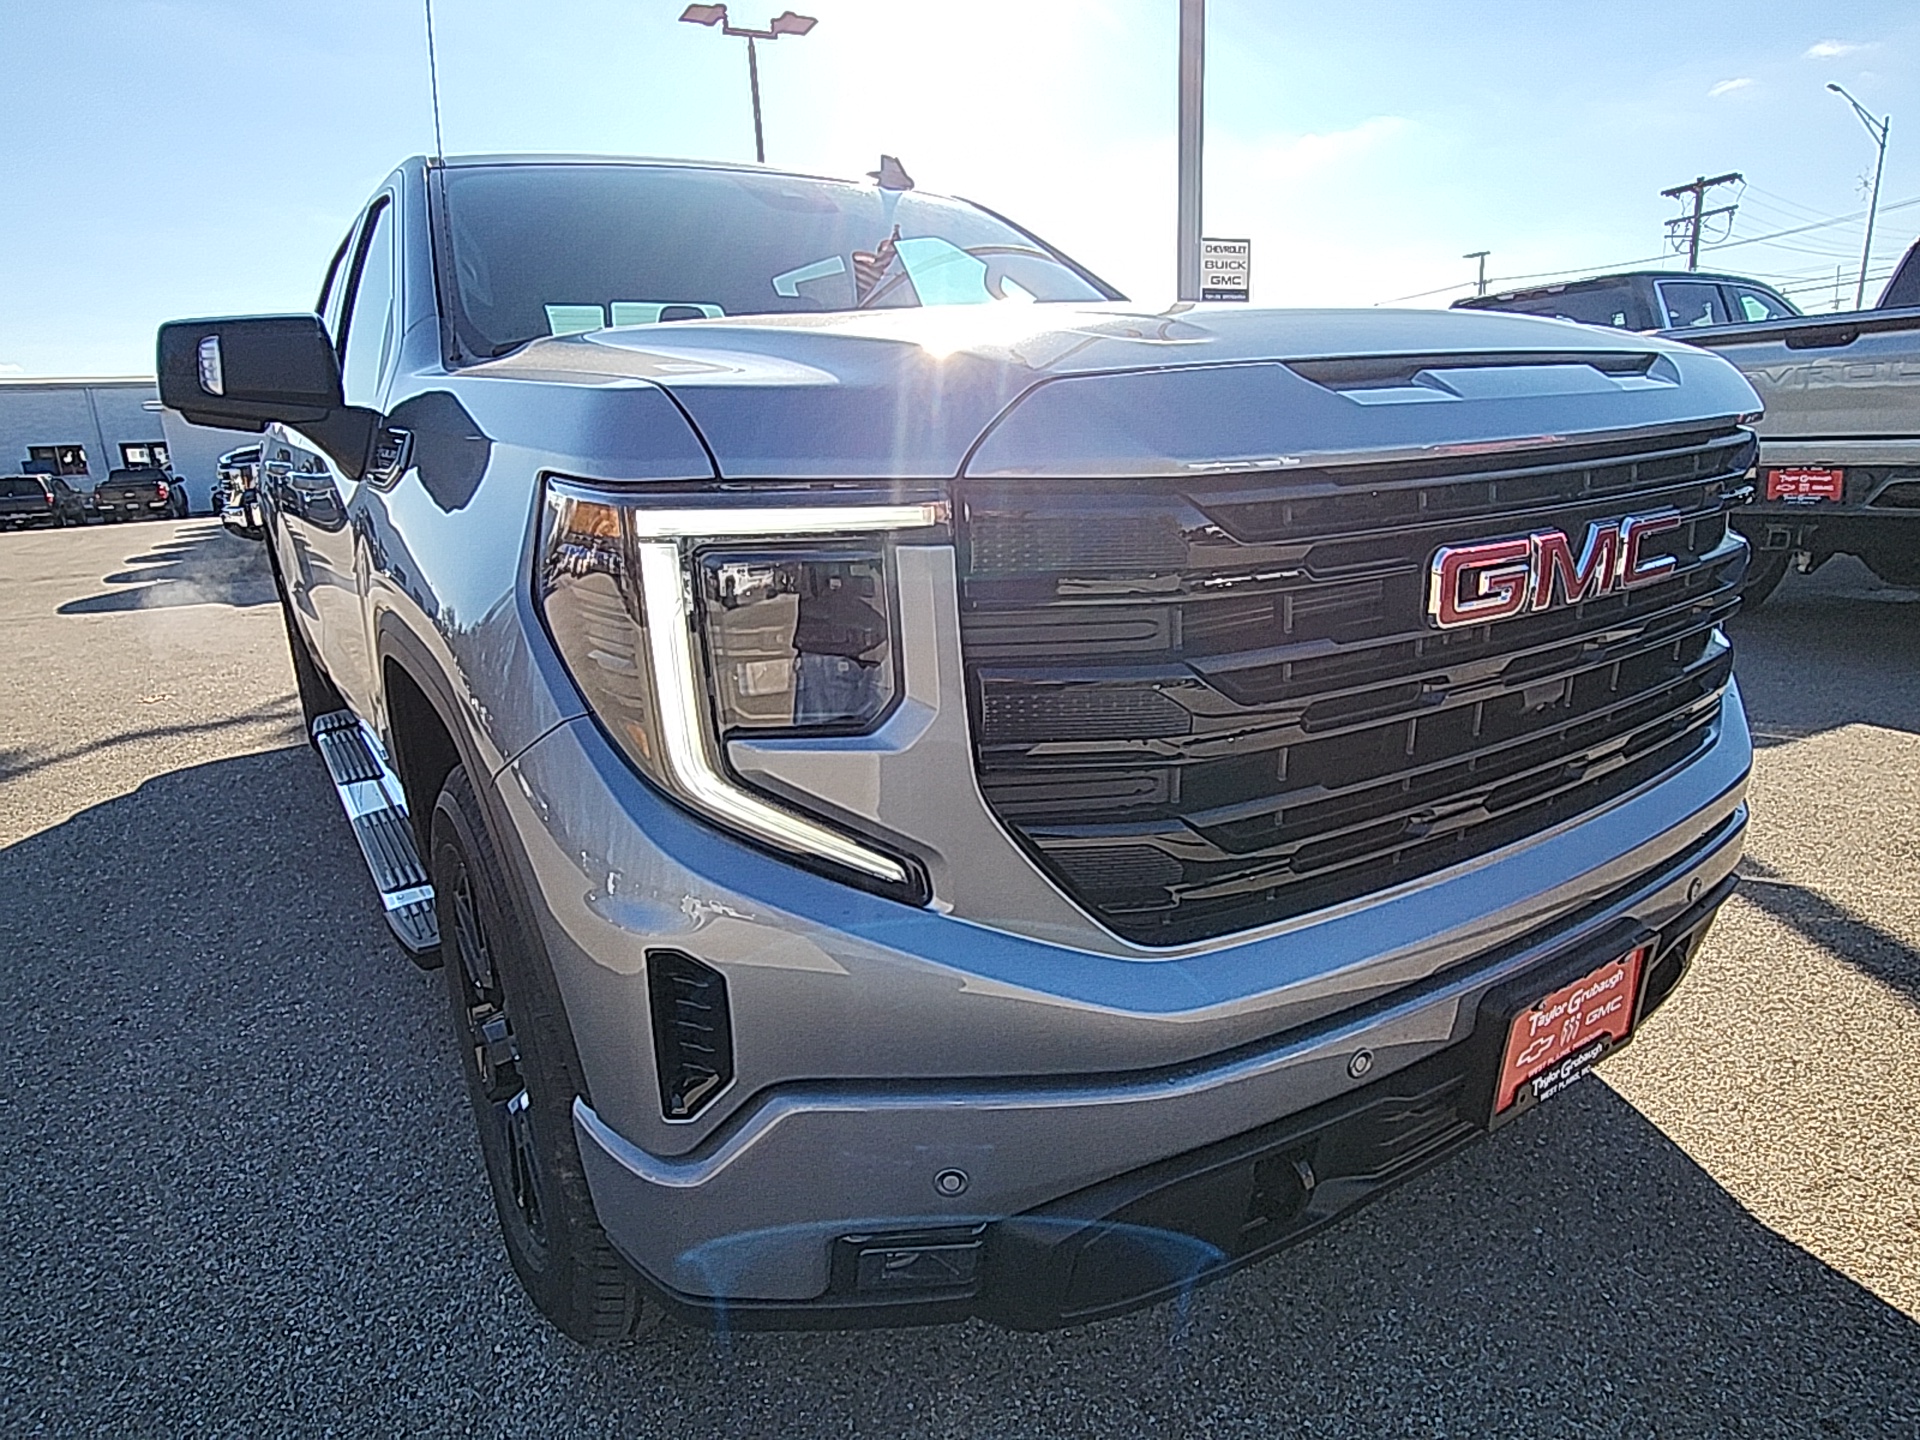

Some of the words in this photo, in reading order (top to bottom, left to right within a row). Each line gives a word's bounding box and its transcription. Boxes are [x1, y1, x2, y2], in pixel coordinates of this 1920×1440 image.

[1204, 260, 1246, 270] BUICK
[1210, 275, 1242, 286] GMC
[1428, 510, 1681, 630] GMC
[1529, 1003, 1568, 1037] Taylor
[1585, 995, 1623, 1026] GMC
